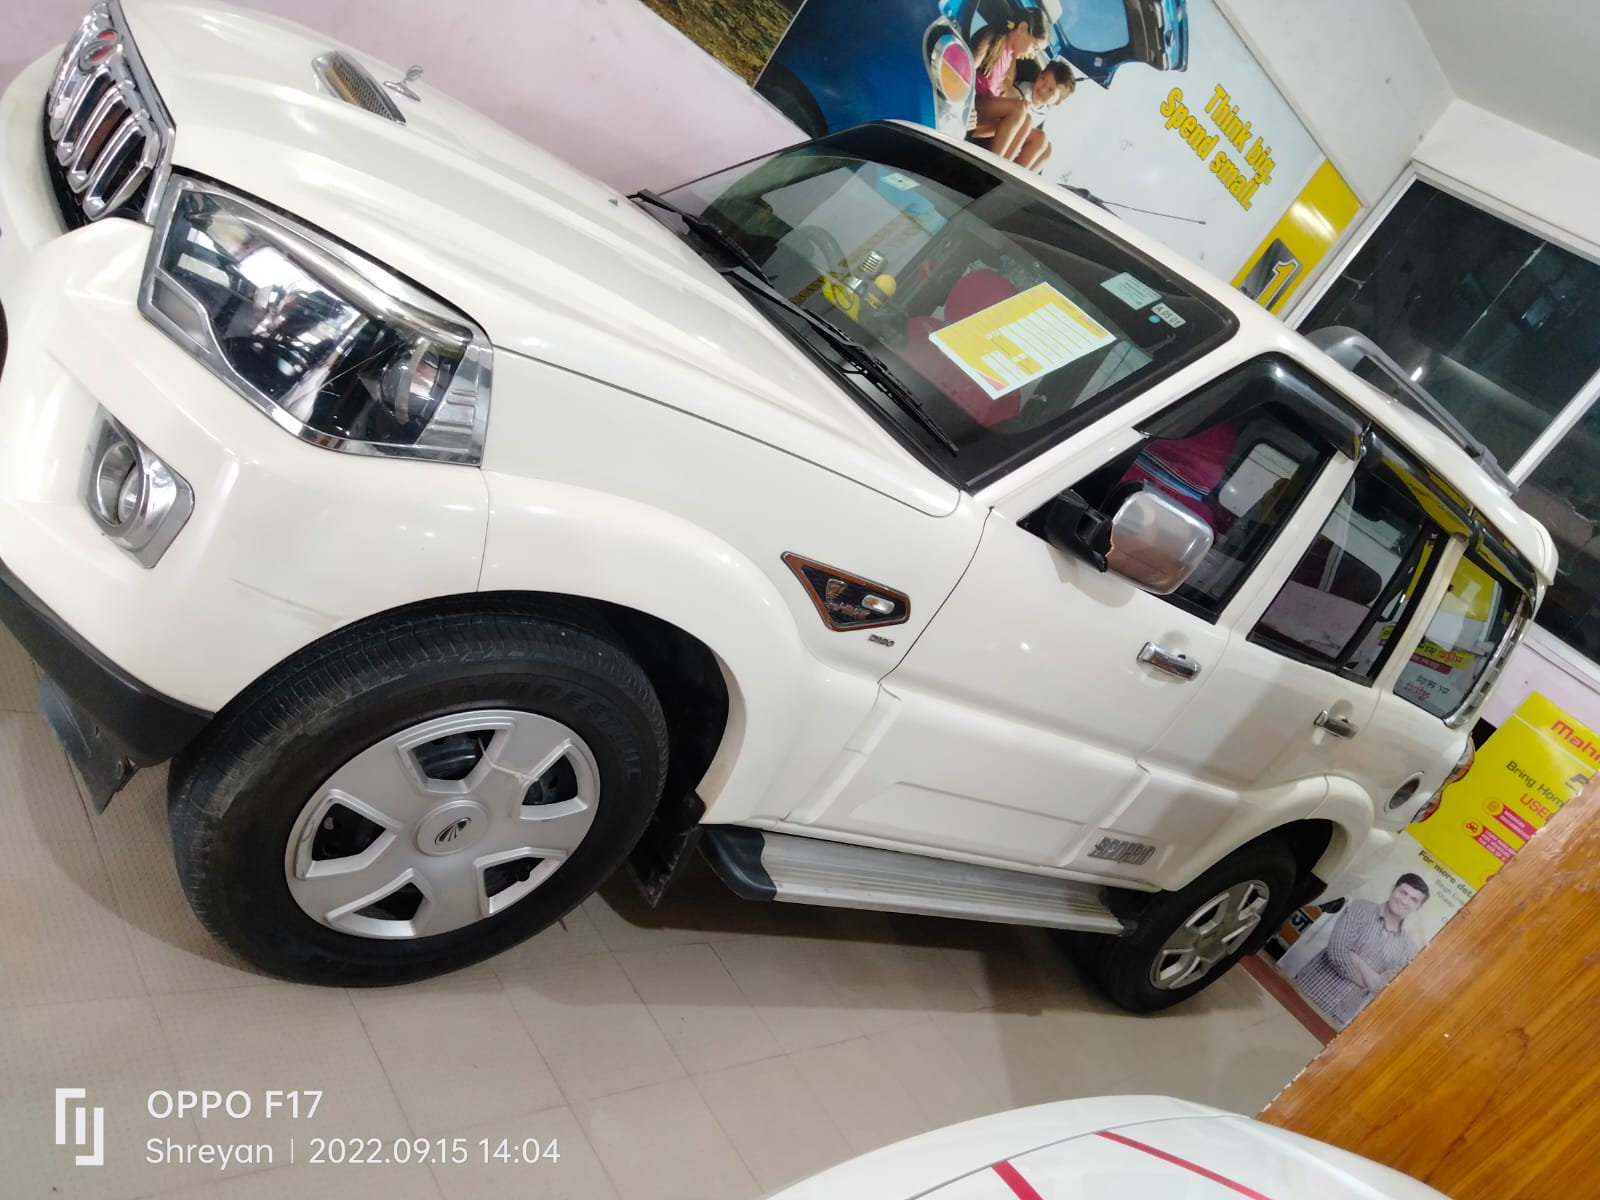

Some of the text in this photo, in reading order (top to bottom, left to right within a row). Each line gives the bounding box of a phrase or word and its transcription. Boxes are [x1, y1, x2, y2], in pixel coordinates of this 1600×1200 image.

[1160, 87, 1260, 212] Spend small.
[1204, 83, 1276, 186] Think big.
[1506, 761, 1536, 788] Bring
[1537, 784, 1565, 807] Hom
[1418, 850, 1473, 898] For more det
